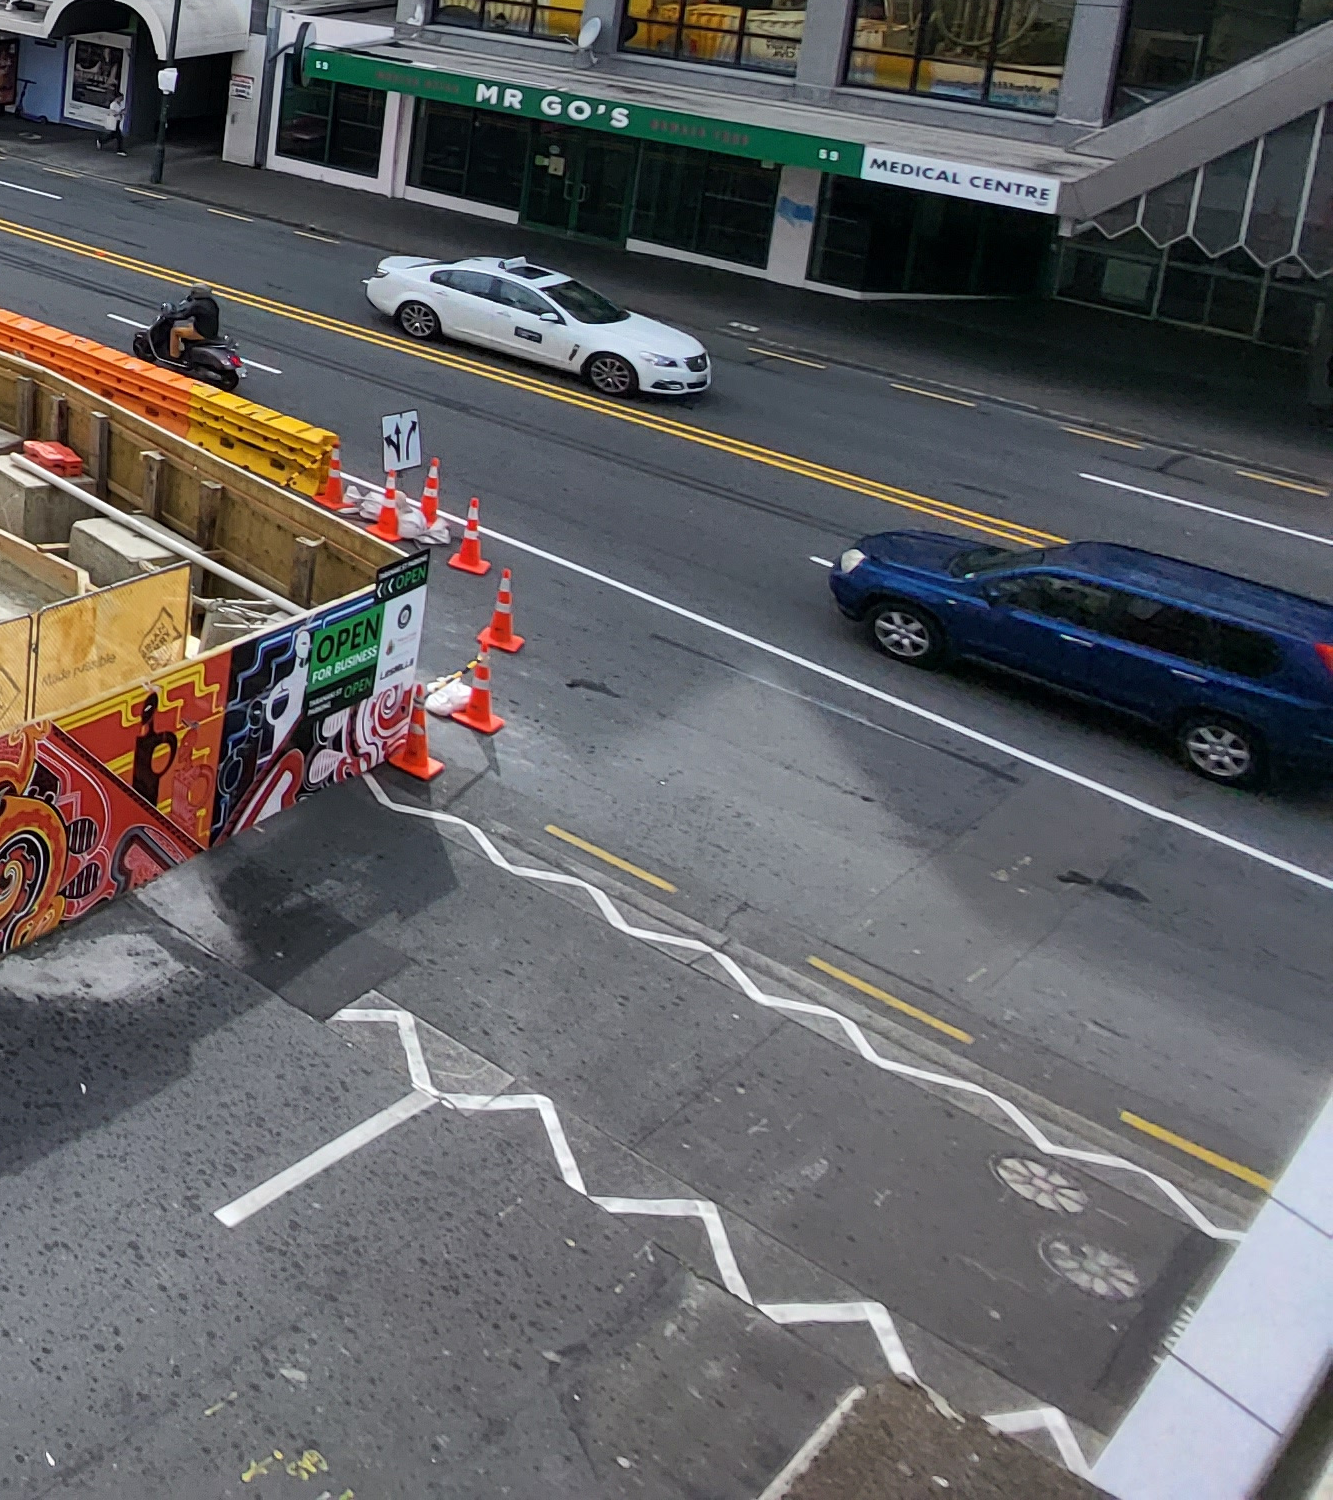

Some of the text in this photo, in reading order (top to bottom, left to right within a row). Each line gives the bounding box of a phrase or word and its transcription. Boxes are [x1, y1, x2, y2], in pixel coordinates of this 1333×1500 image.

[475, 84, 630, 129] MR GO'S
[870, 158, 1051, 201] MEDICAL CENTRE
[396, 564, 427, 590] OPEN
[316, 613, 380, 664] OPEN
[312, 645, 379, 684] FOR BUSINESS
[344, 676, 372, 699] OPEN
